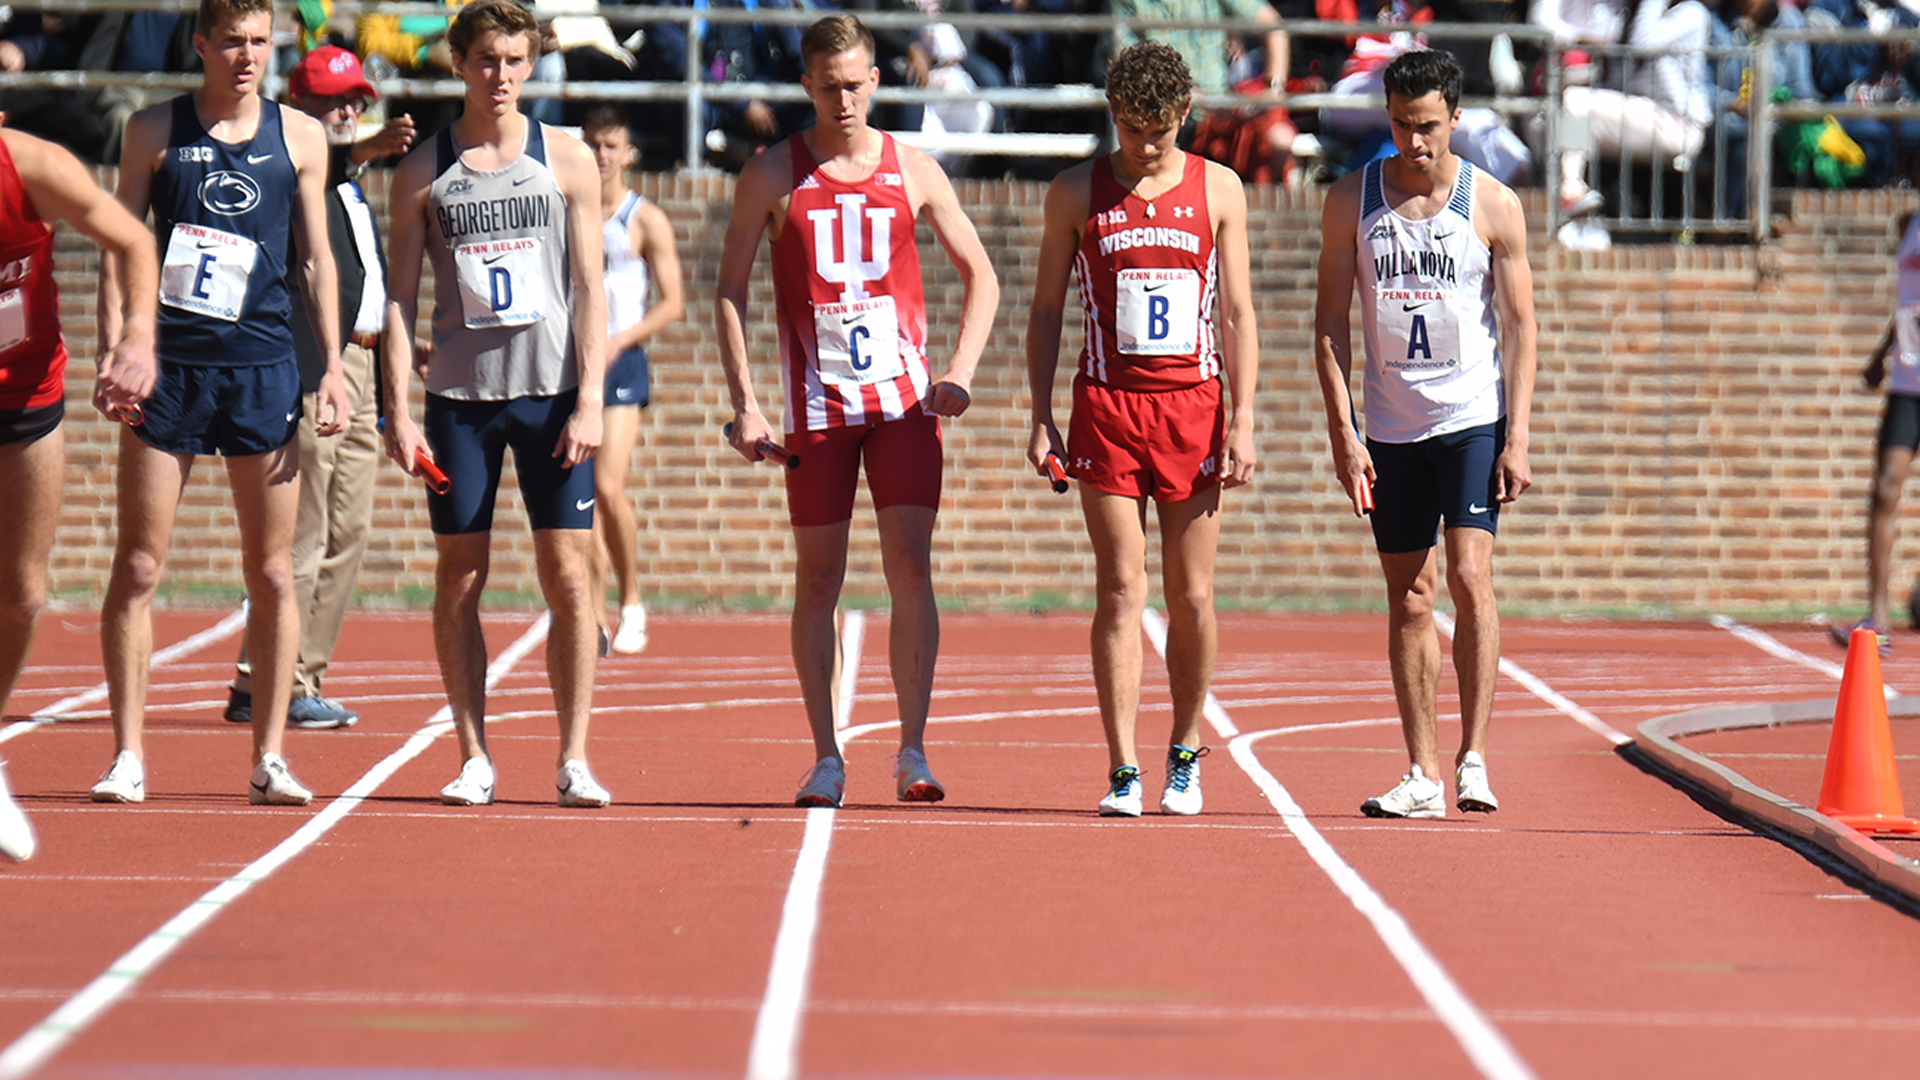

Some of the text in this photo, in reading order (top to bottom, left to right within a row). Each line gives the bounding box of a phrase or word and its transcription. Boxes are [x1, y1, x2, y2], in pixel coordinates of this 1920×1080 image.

[178, 224, 207, 238] PENN
[437, 194, 550, 239] GEORGETOWN
[460, 240, 534, 255] PENN RELAYS
[1098, 227, 1200, 256] WISCONSIN
[191, 253, 216, 299] E
[1122, 272, 1151, 281] PENN
[1374, 251, 1456, 285] VILLANOVA
[488, 267, 513, 312] D
[1382, 291, 1410, 300] PENN
[820, 305, 848, 315] PENN
[1148, 295, 1169, 340] B
[849, 325, 873, 371] C
[1407, 315, 1432, 359] A
